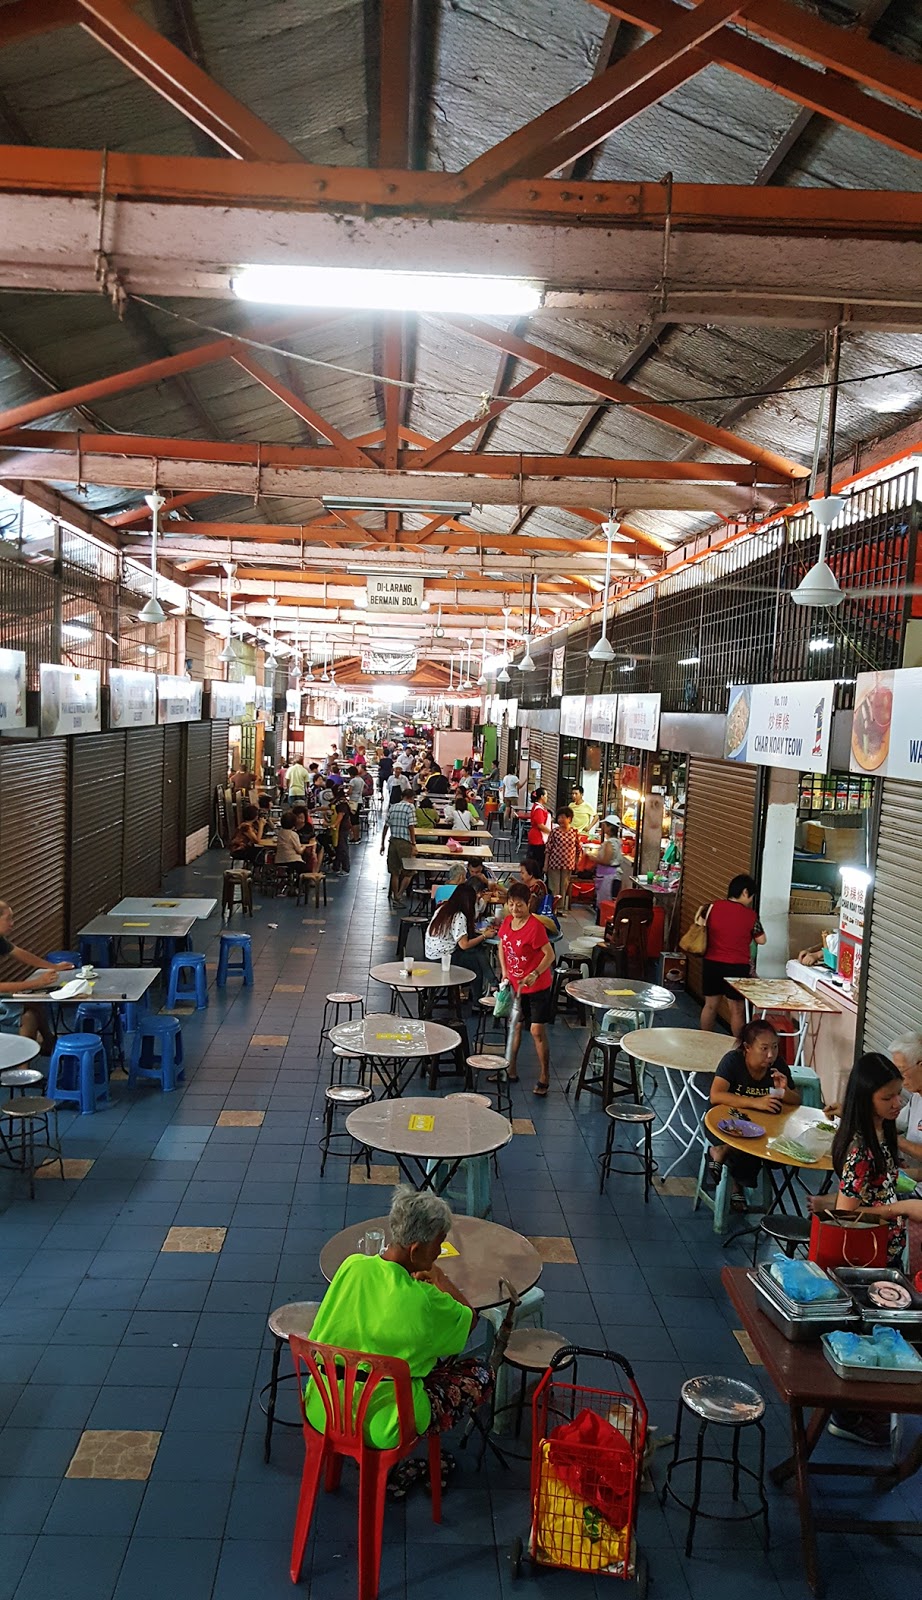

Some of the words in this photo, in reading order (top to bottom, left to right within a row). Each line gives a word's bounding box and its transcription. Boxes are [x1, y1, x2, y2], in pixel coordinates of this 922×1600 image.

[377, 583, 412, 593] DI-LARANG
[371, 596, 399, 605] BERMAIN
[402, 597, 418, 606] BOLA
[755, 735, 769, 752] CHAR
[769, 737, 784, 754] KOAY
[785, 738, 803, 756] TEOW
[746, 1087, 769, 1095] REALL
